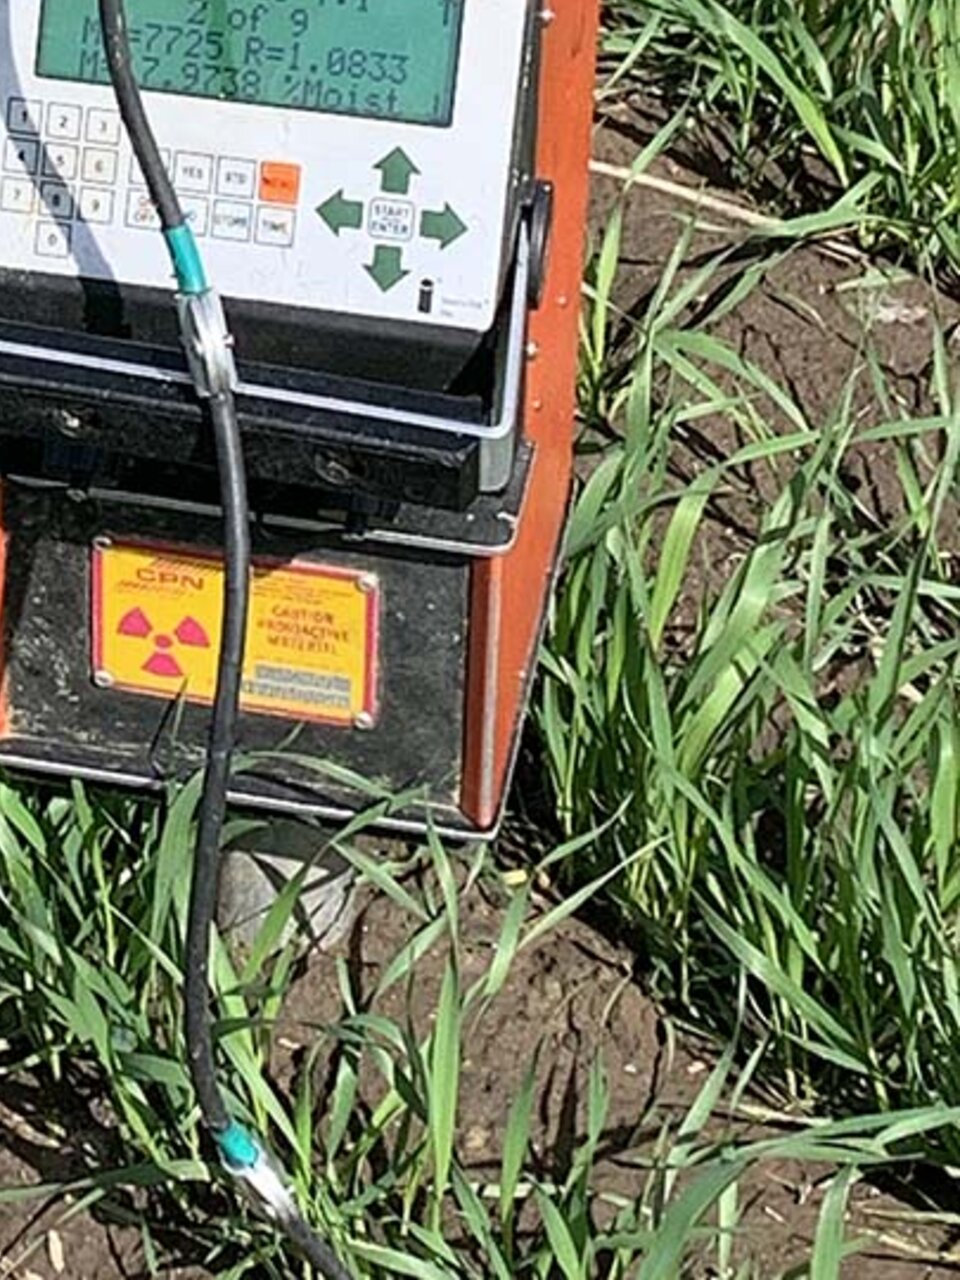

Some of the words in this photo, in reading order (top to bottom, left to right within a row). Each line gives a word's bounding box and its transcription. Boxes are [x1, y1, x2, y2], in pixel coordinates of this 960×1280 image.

[227, 4, 268, 32] of
[290, 8, 309, 37] 9
[244, 37, 410, 85] R=1.0833
[182, 167, 204, 180] YES
[374, 204, 409, 218] START
[372, 221, 408, 235] ENTER
[136, 567, 205, 591] CPN
[271, 604, 335, 625] CAUTION
[266, 635, 337, 656] MATERIAL
